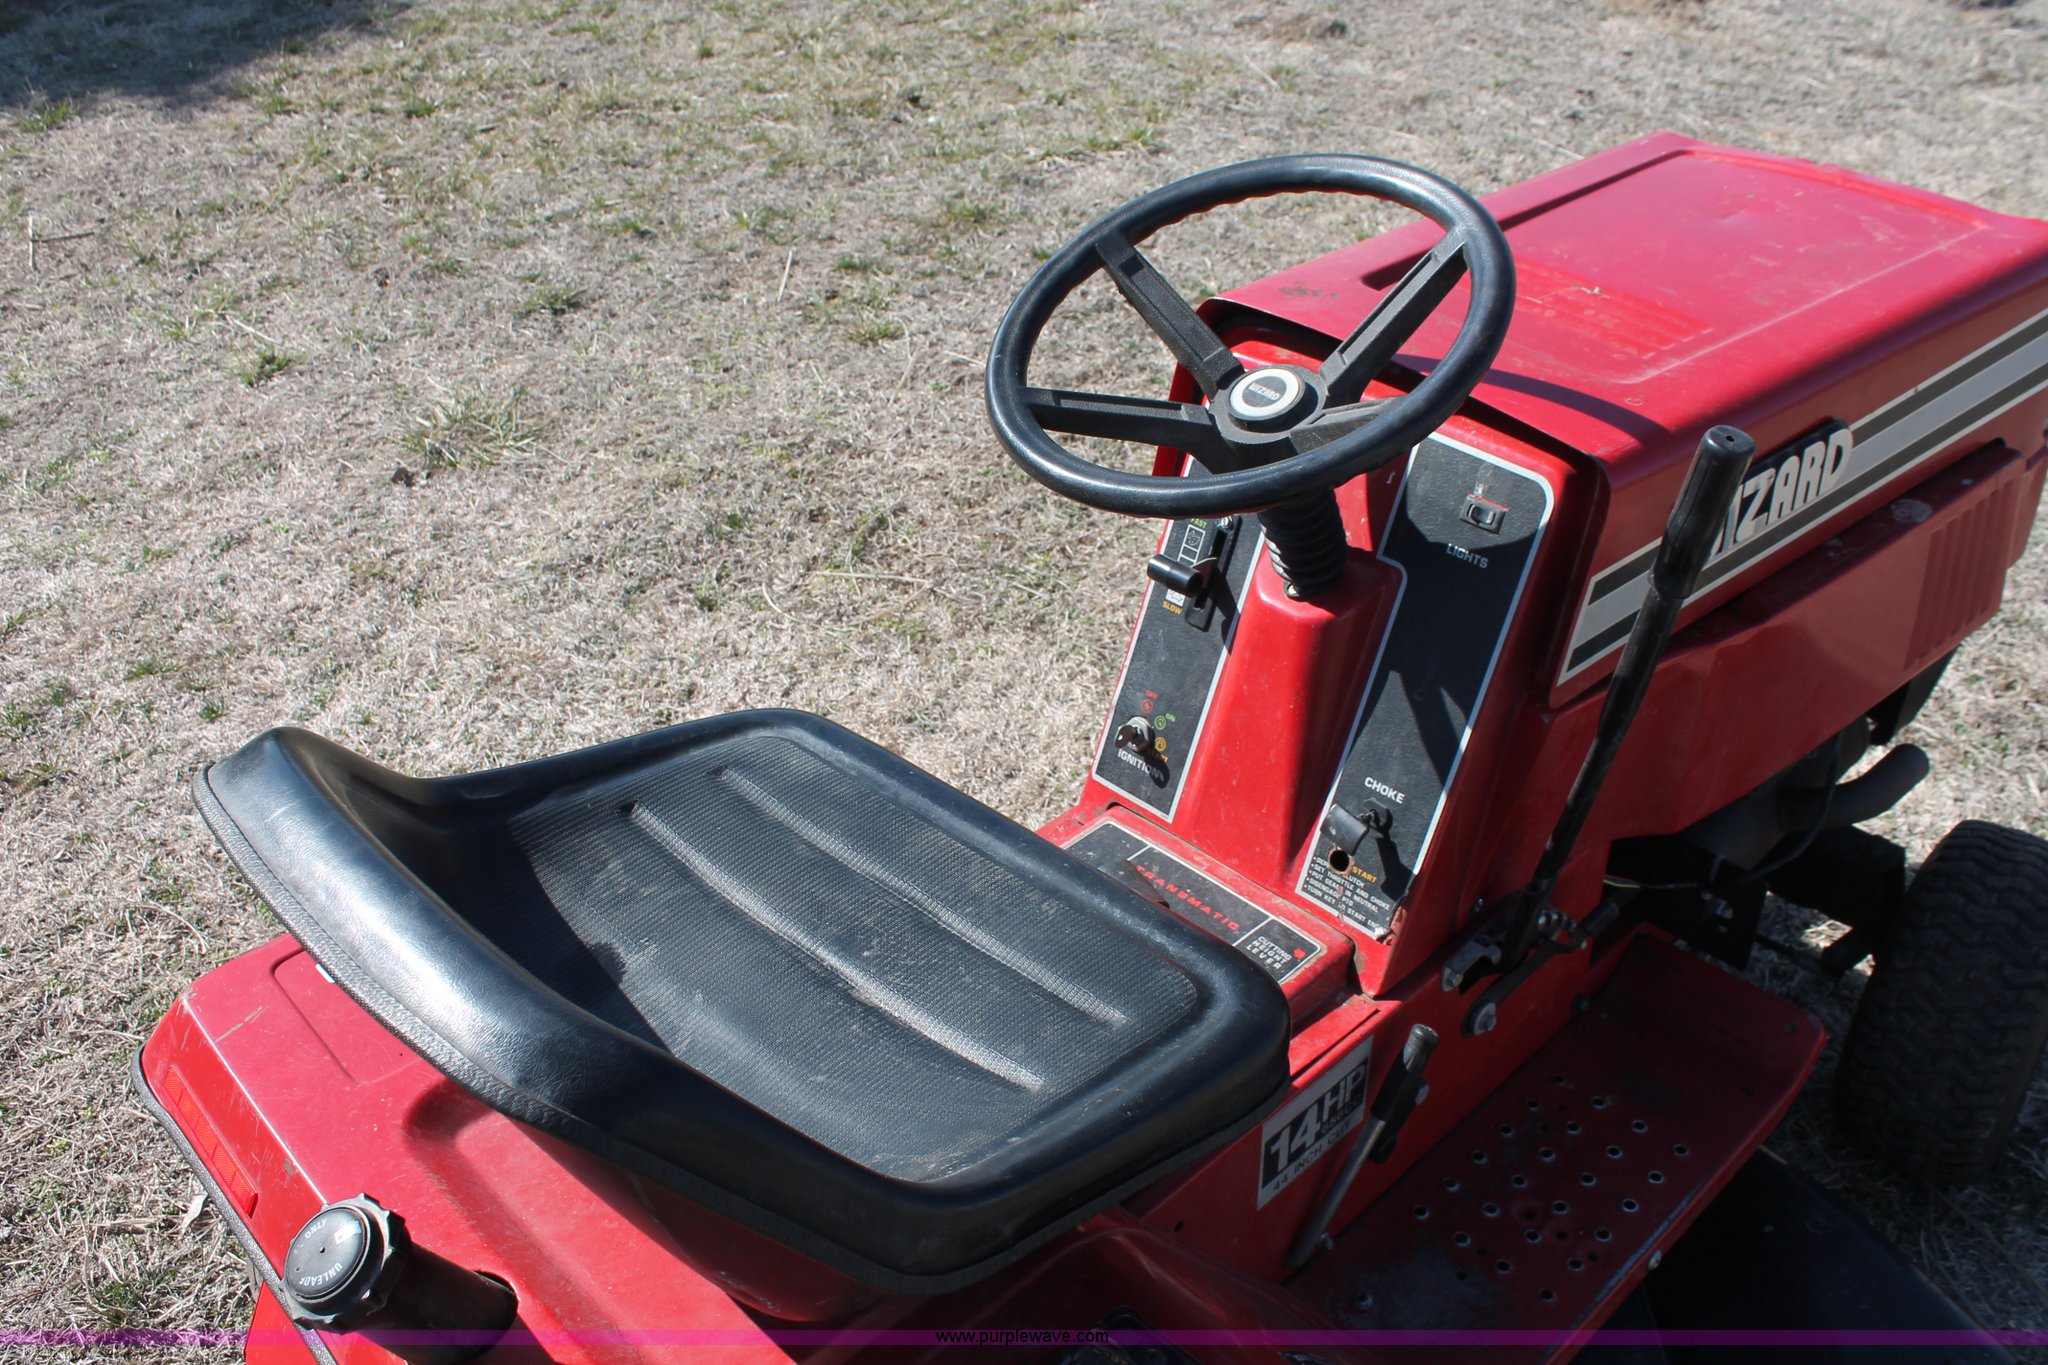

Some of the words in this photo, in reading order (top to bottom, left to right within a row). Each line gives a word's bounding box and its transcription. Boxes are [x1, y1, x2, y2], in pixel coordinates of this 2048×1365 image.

[1709, 428, 1854, 558] IZARD
[1446, 543, 1489, 569] LIGHTS
[1162, 600, 1183, 615] SLOW
[1144, 689, 1159, 699] OFF
[1165, 712, 1176, 722] ON
[1117, 748, 1160, 779] IGNITION
[1364, 776, 1406, 805] CHOKE
[1311, 871, 1324, 881] PUT
[1345, 889, 1352, 898] IN
[1313, 863, 1326, 873] SET
[1327, 871, 1355, 891] THROTTLE
[1355, 888, 1369, 899] AND
[1351, 866, 1378, 883] START
[1136, 865, 1240, 931] TRANSMATIC
[1323, 895, 1336, 904] KEY
[1346, 907, 1367, 921] START
[1341, 895, 1354, 906] PTO
[1246, 944, 1282, 969] LEVER
[1251, 940, 1288, 964] HEIGHT
[1257, 935, 1292, 960] CUTTING
[1273, 1174, 1289, 1191] 44
[1294, 1142, 1323, 1174] INCH
[1327, 1118, 1352, 1145] CUT
[304, 1217, 328, 1240] ONLY
